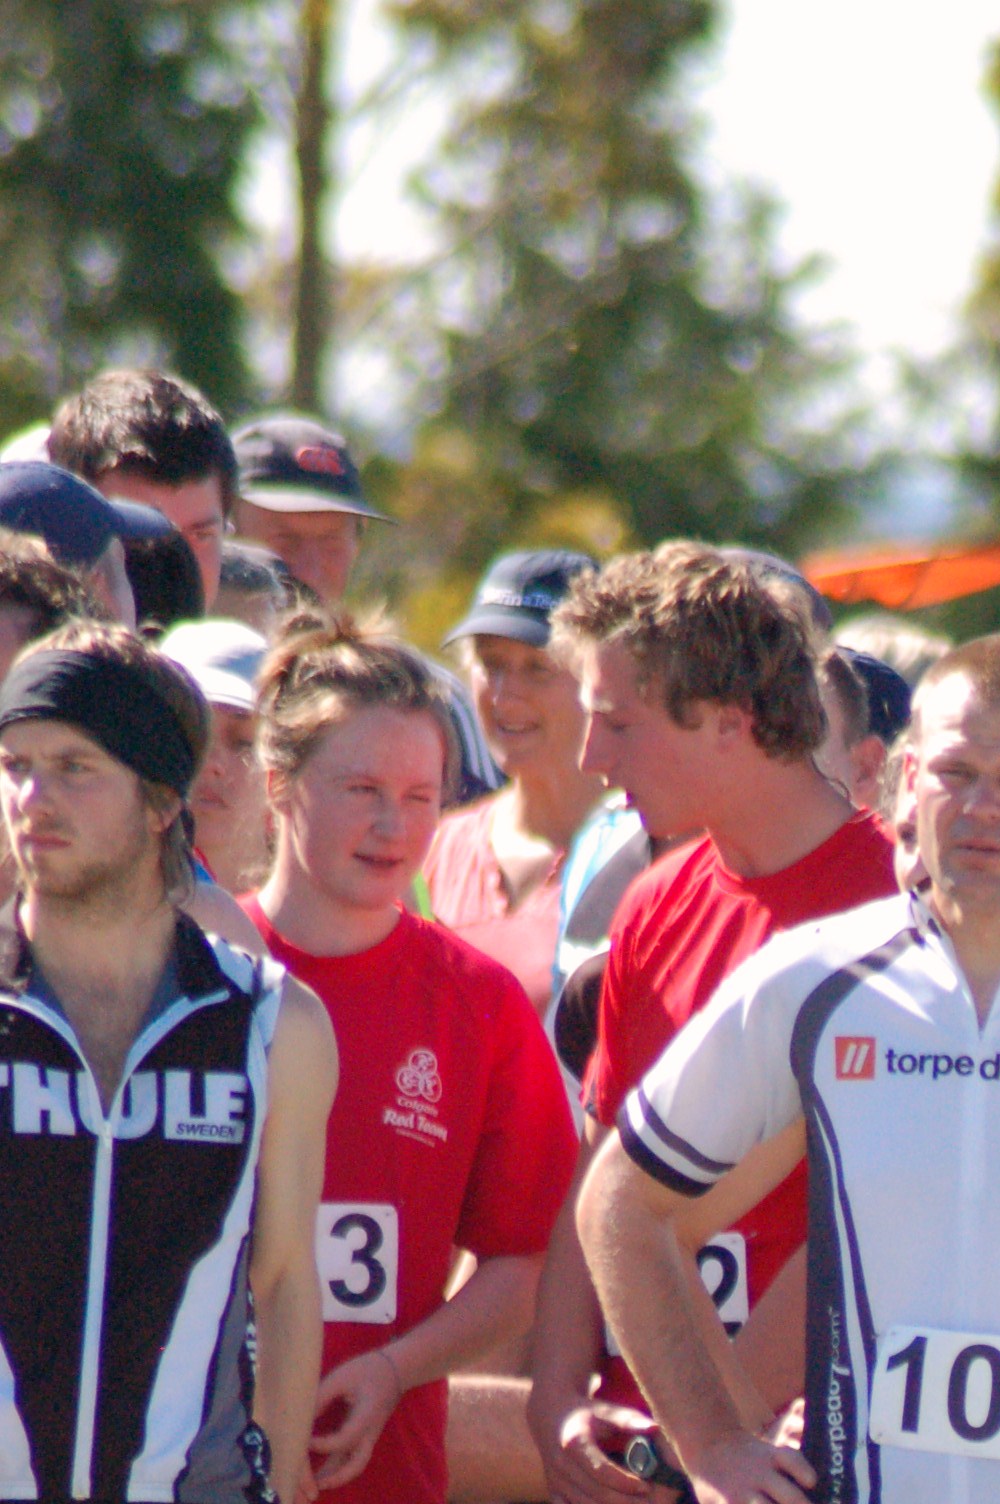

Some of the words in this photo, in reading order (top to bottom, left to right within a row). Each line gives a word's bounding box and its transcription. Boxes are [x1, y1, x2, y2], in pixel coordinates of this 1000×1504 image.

[0, 1062, 247, 1144] HULE
[175, 1121, 237, 1138] SWEDEN
[328, 1213, 387, 1309] 3
